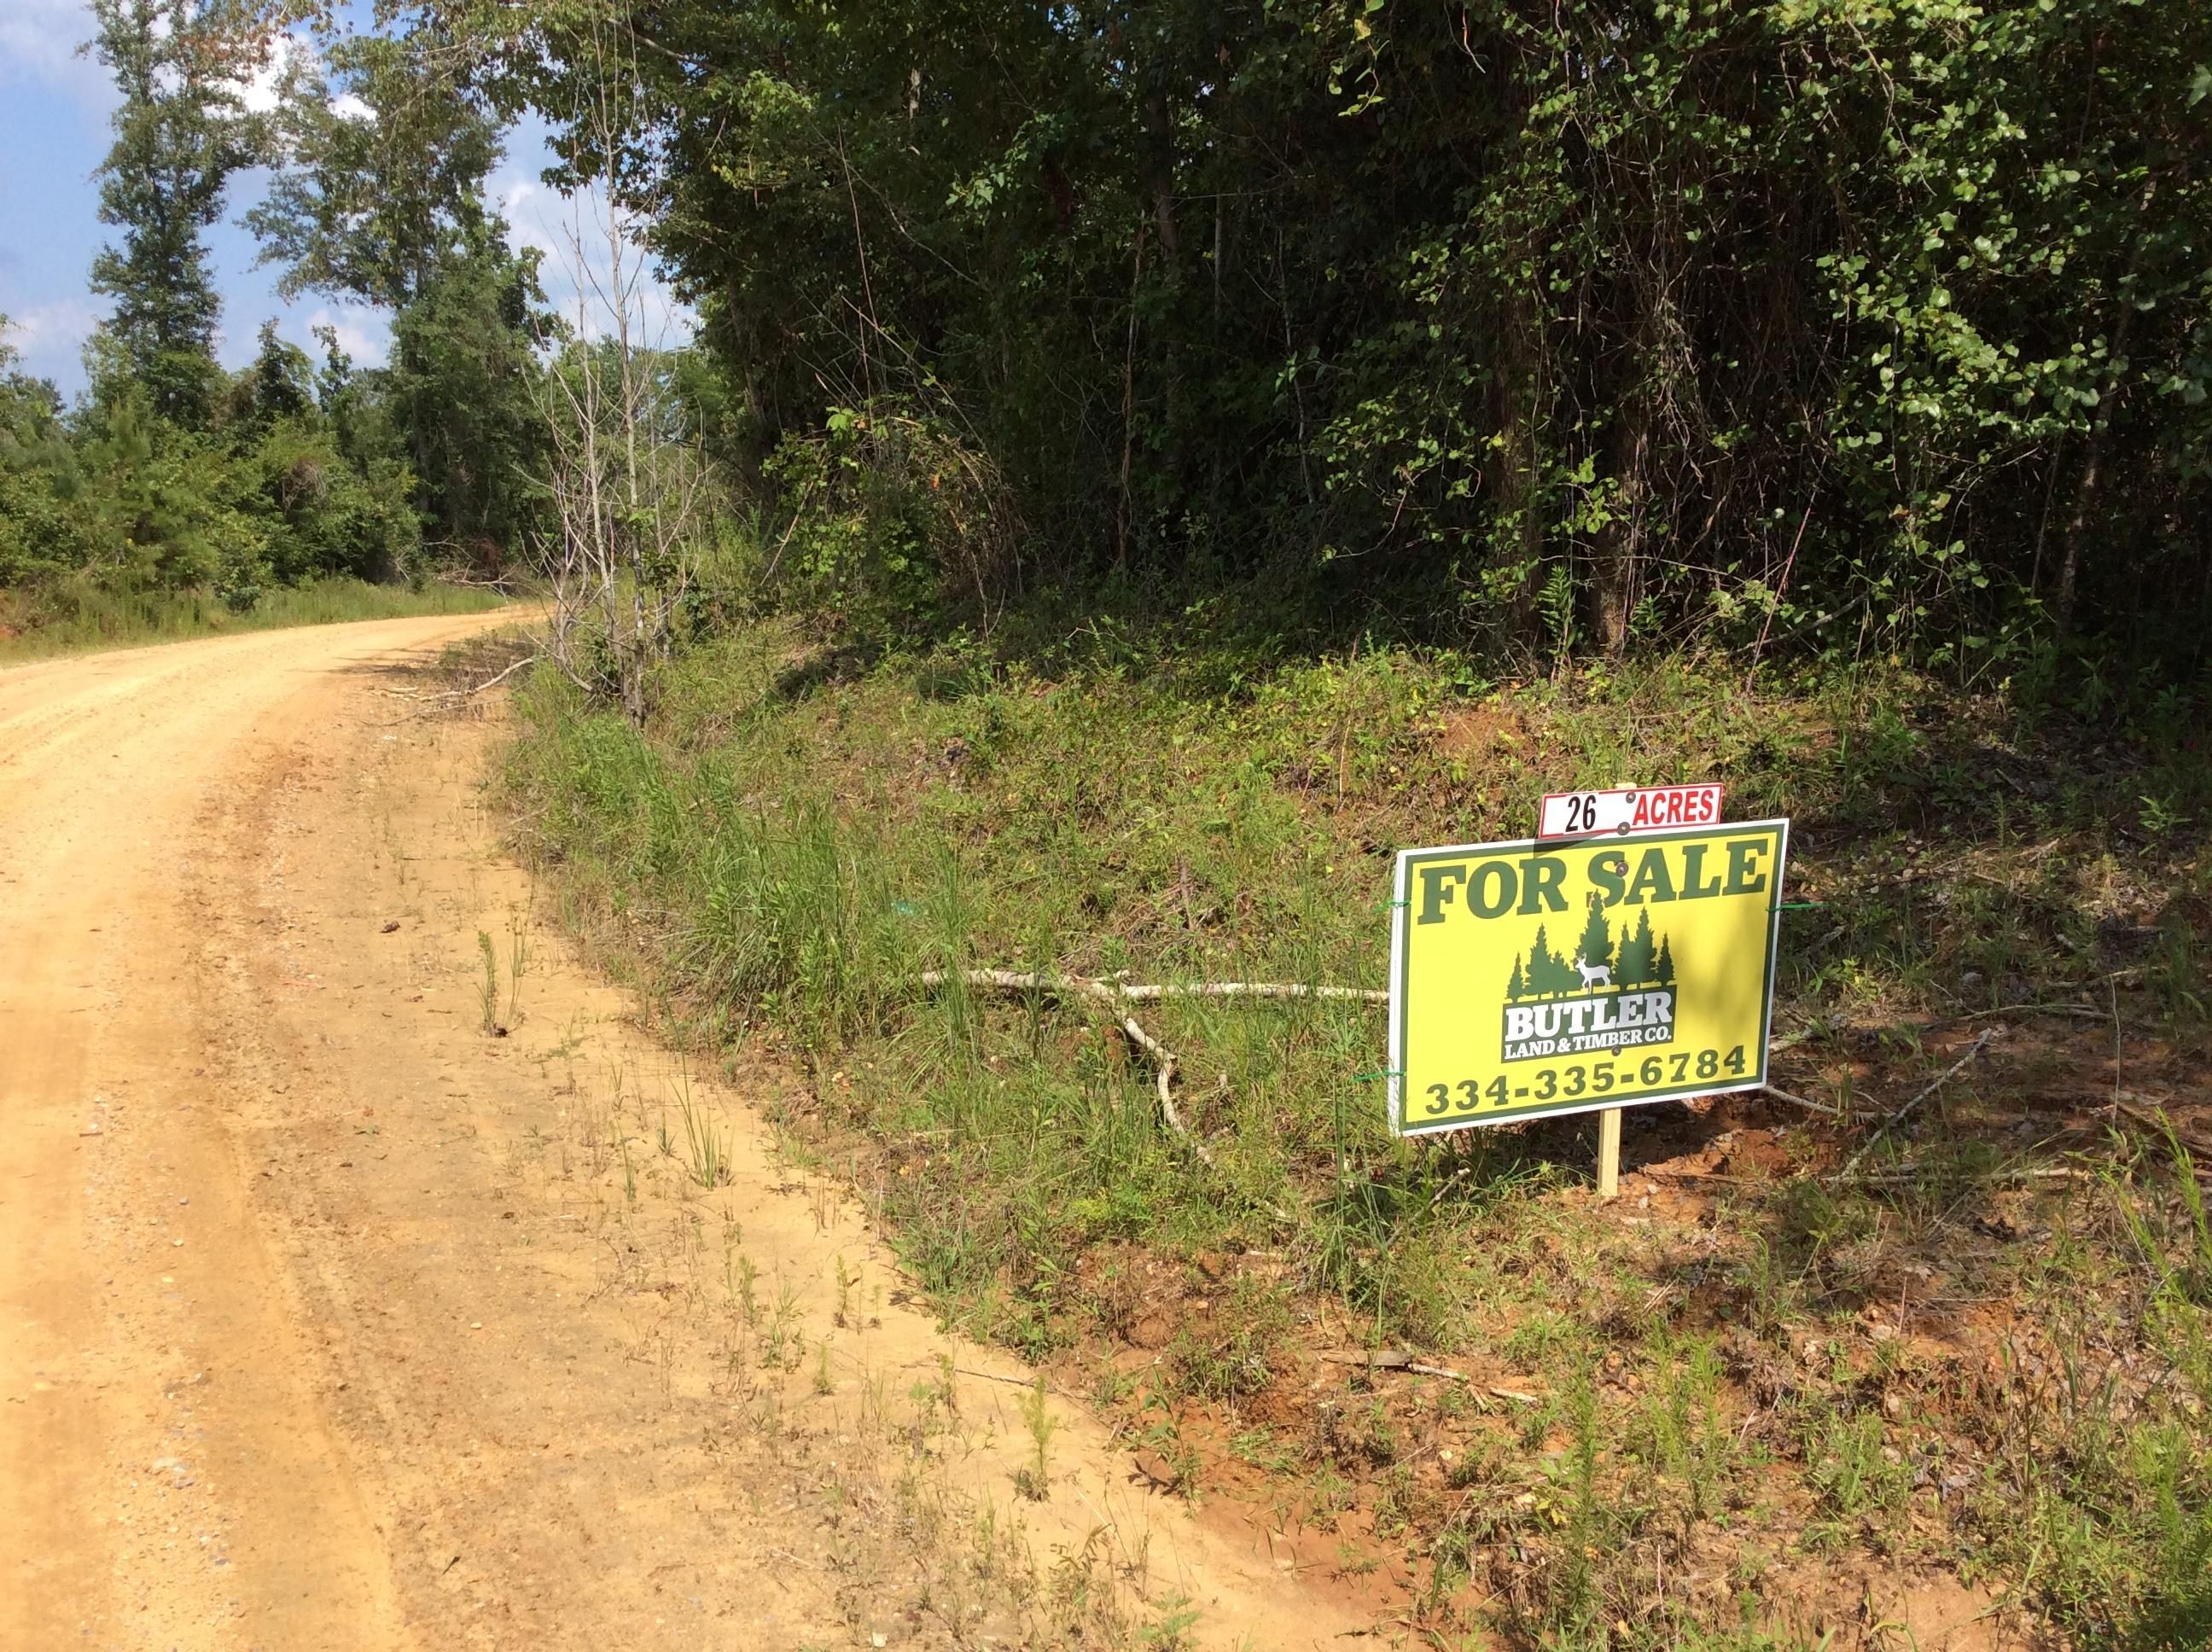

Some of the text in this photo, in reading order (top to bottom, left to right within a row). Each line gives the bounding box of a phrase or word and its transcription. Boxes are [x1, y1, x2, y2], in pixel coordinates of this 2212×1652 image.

[1565, 790, 1714, 833] 26 ACRES
[1417, 838, 1768, 925] FOR SALE
[1505, 991, 1673, 1042] BUTLER
[1504, 1026, 1673, 1060] LAND & TIMBER CO.
[1425, 1045, 1746, 1114] 334-335-6784
